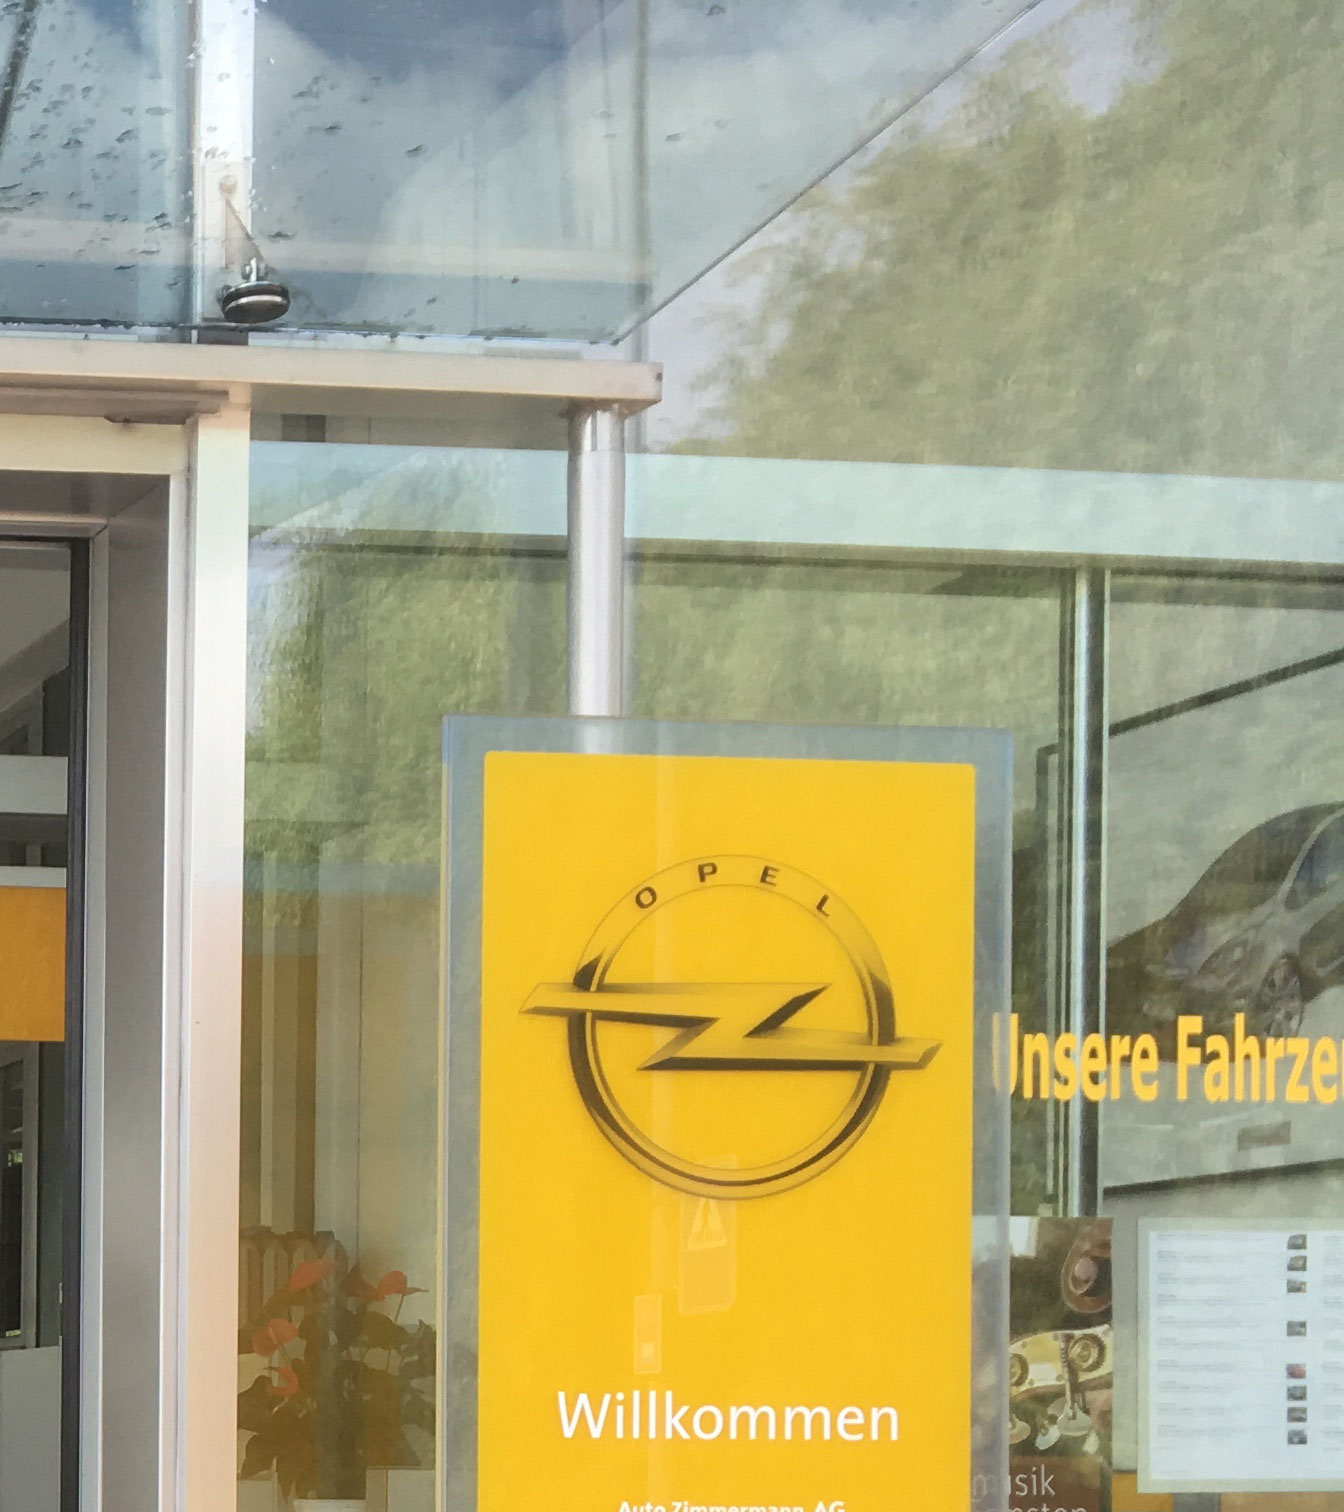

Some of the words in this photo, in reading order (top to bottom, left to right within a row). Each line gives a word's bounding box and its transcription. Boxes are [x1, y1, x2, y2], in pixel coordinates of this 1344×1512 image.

[634, 861, 831, 918] OPEL
[991, 1011, 1160, 1103] Unsere
[1176, 1011, 1344, 1104] Fahrze
[557, 1389, 900, 1442] Willkommen
